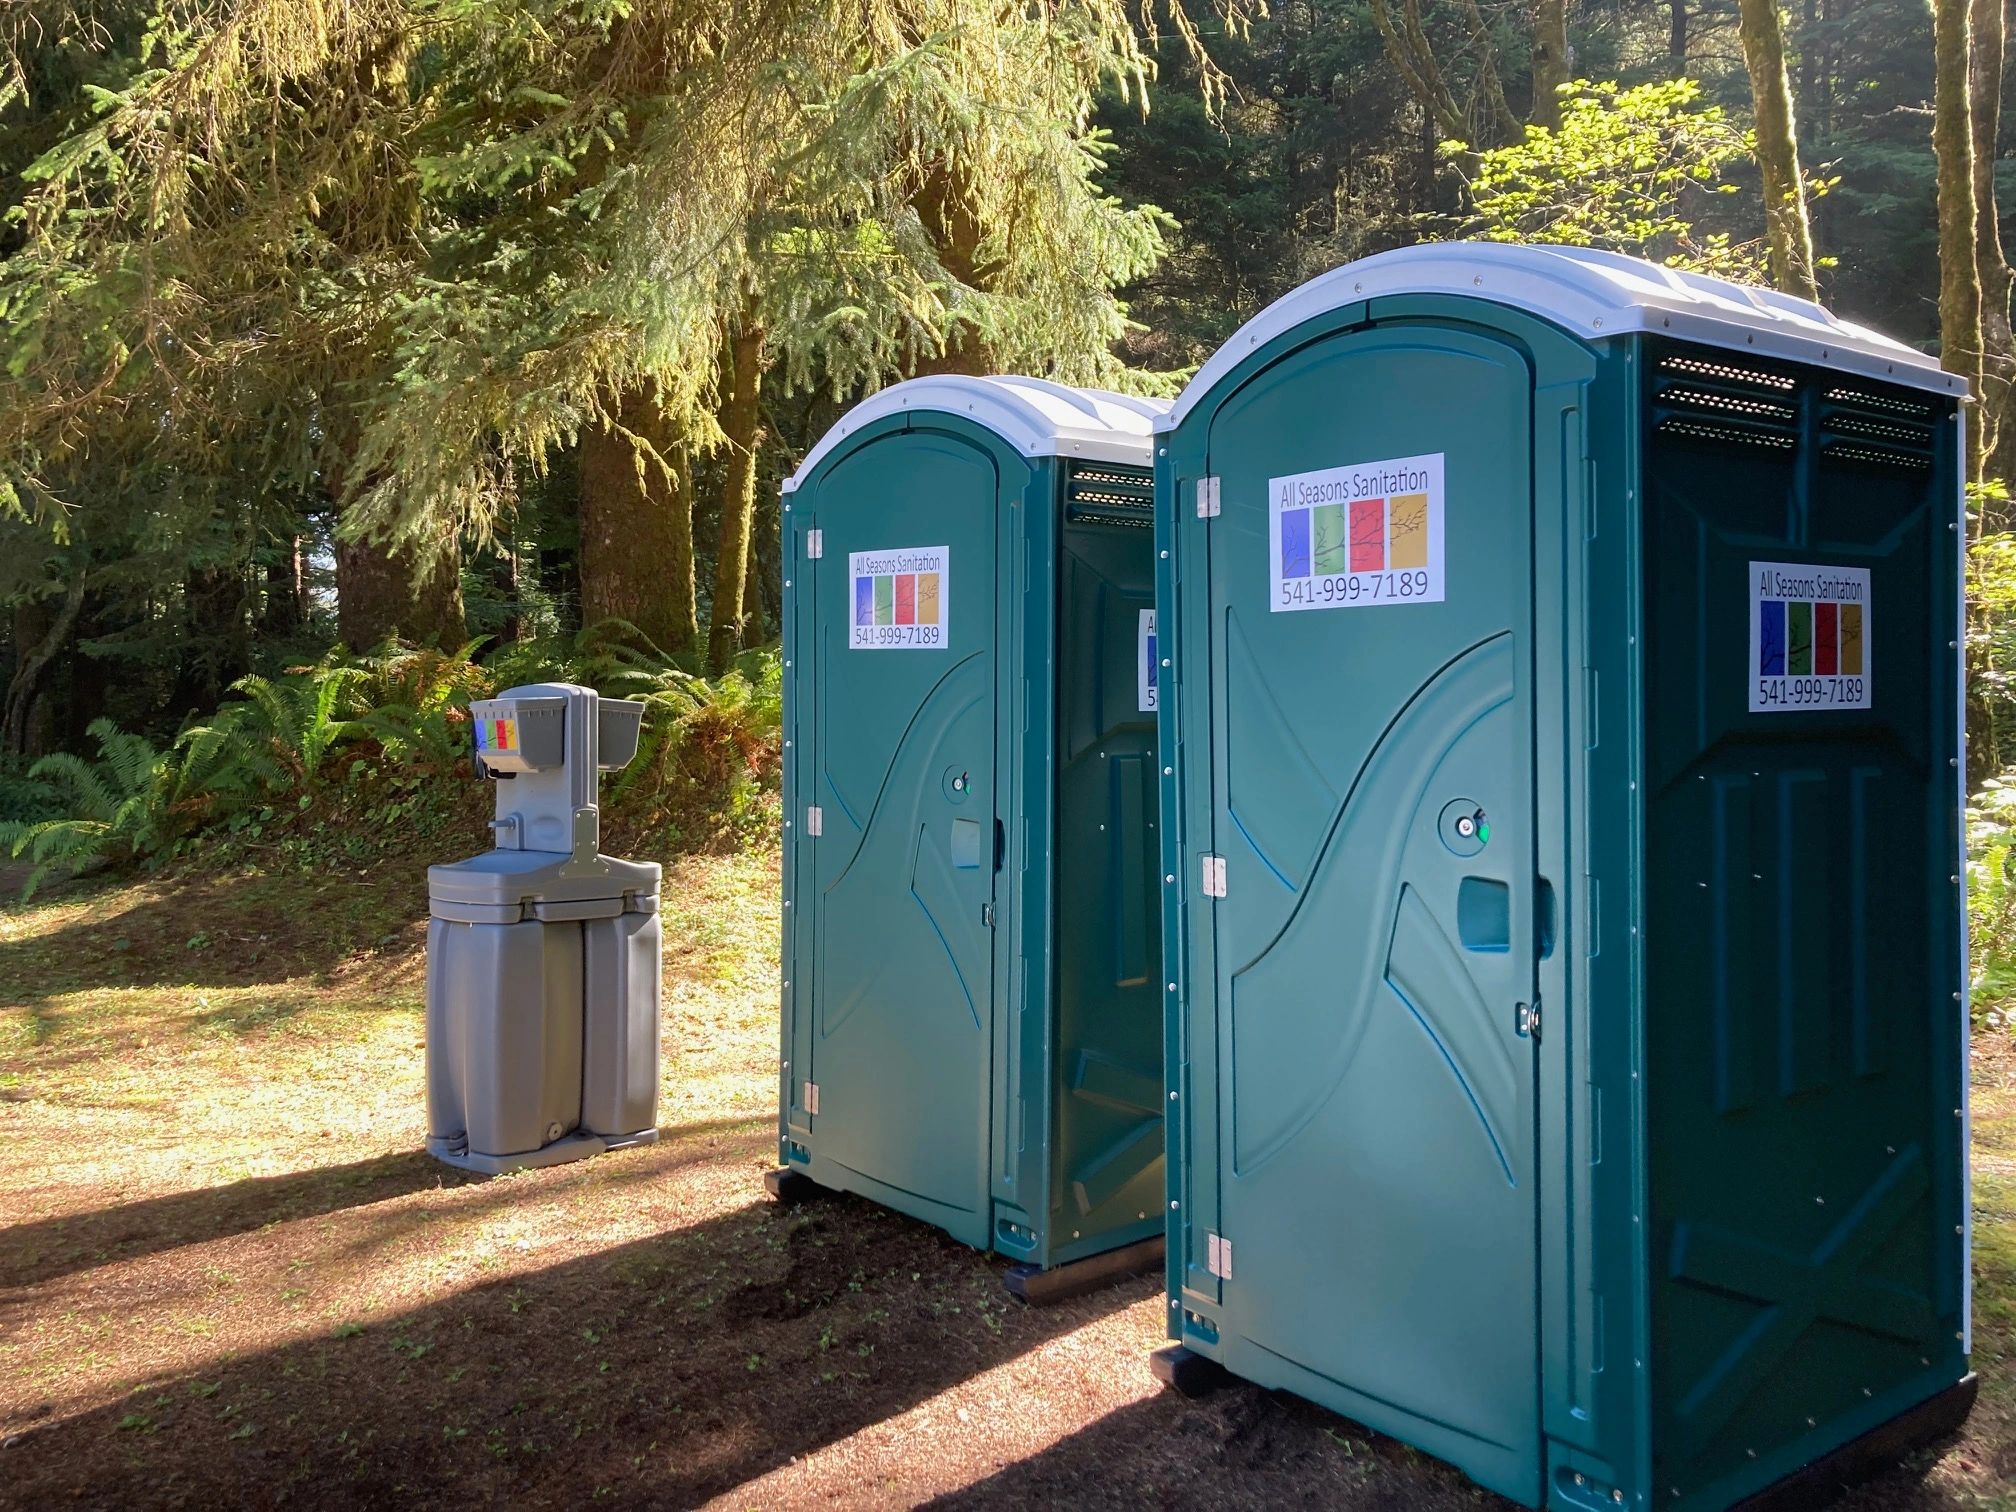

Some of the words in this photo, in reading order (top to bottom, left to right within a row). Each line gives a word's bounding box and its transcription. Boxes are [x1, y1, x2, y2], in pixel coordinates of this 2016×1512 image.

[1280, 481, 1295, 508] All
[1298, 480, 1349, 506] Seasons
[1353, 466, 1428, 498] Sanitation
[856, 557, 865, 575] All
[866, 557, 895, 574] Seasons
[897, 553, 940, 572] Sanitation
[1281, 571, 1428, 605] 541-999-7189
[1760, 570, 1773, 596] All
[1776, 572, 1815, 598] Seasons
[1817, 574, 1863, 601] Sanitation
[856, 626, 940, 645] 541-999-7189
[1759, 678, 1863, 705] 541-999-7189
